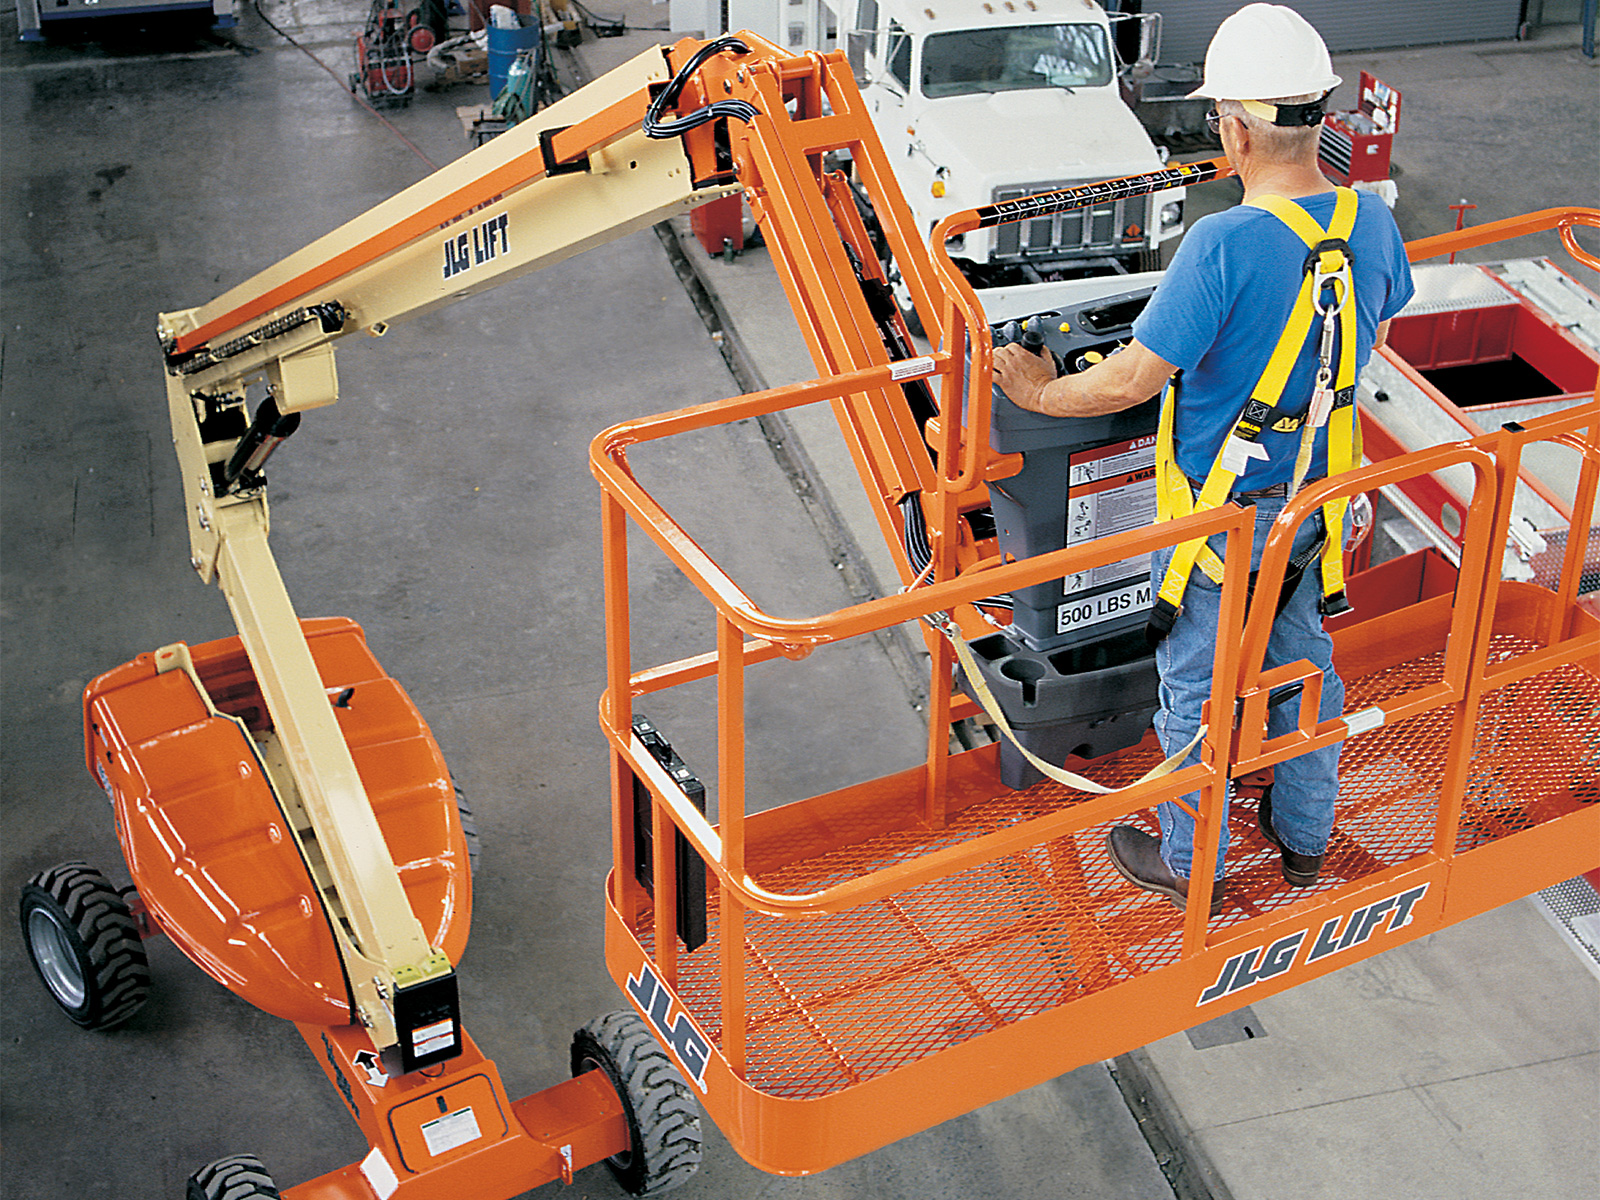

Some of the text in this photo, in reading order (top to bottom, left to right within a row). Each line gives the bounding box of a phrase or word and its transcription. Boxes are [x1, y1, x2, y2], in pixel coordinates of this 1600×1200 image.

[443, 231, 470, 279] JLG
[472, 211, 509, 266] LIFT
[1061, 604, 1091, 625] 500
[1098, 593, 1131, 615] LBS
[1196, 882, 1430, 1007] JLG LIFT
[626, 961, 712, 1086] JLG
